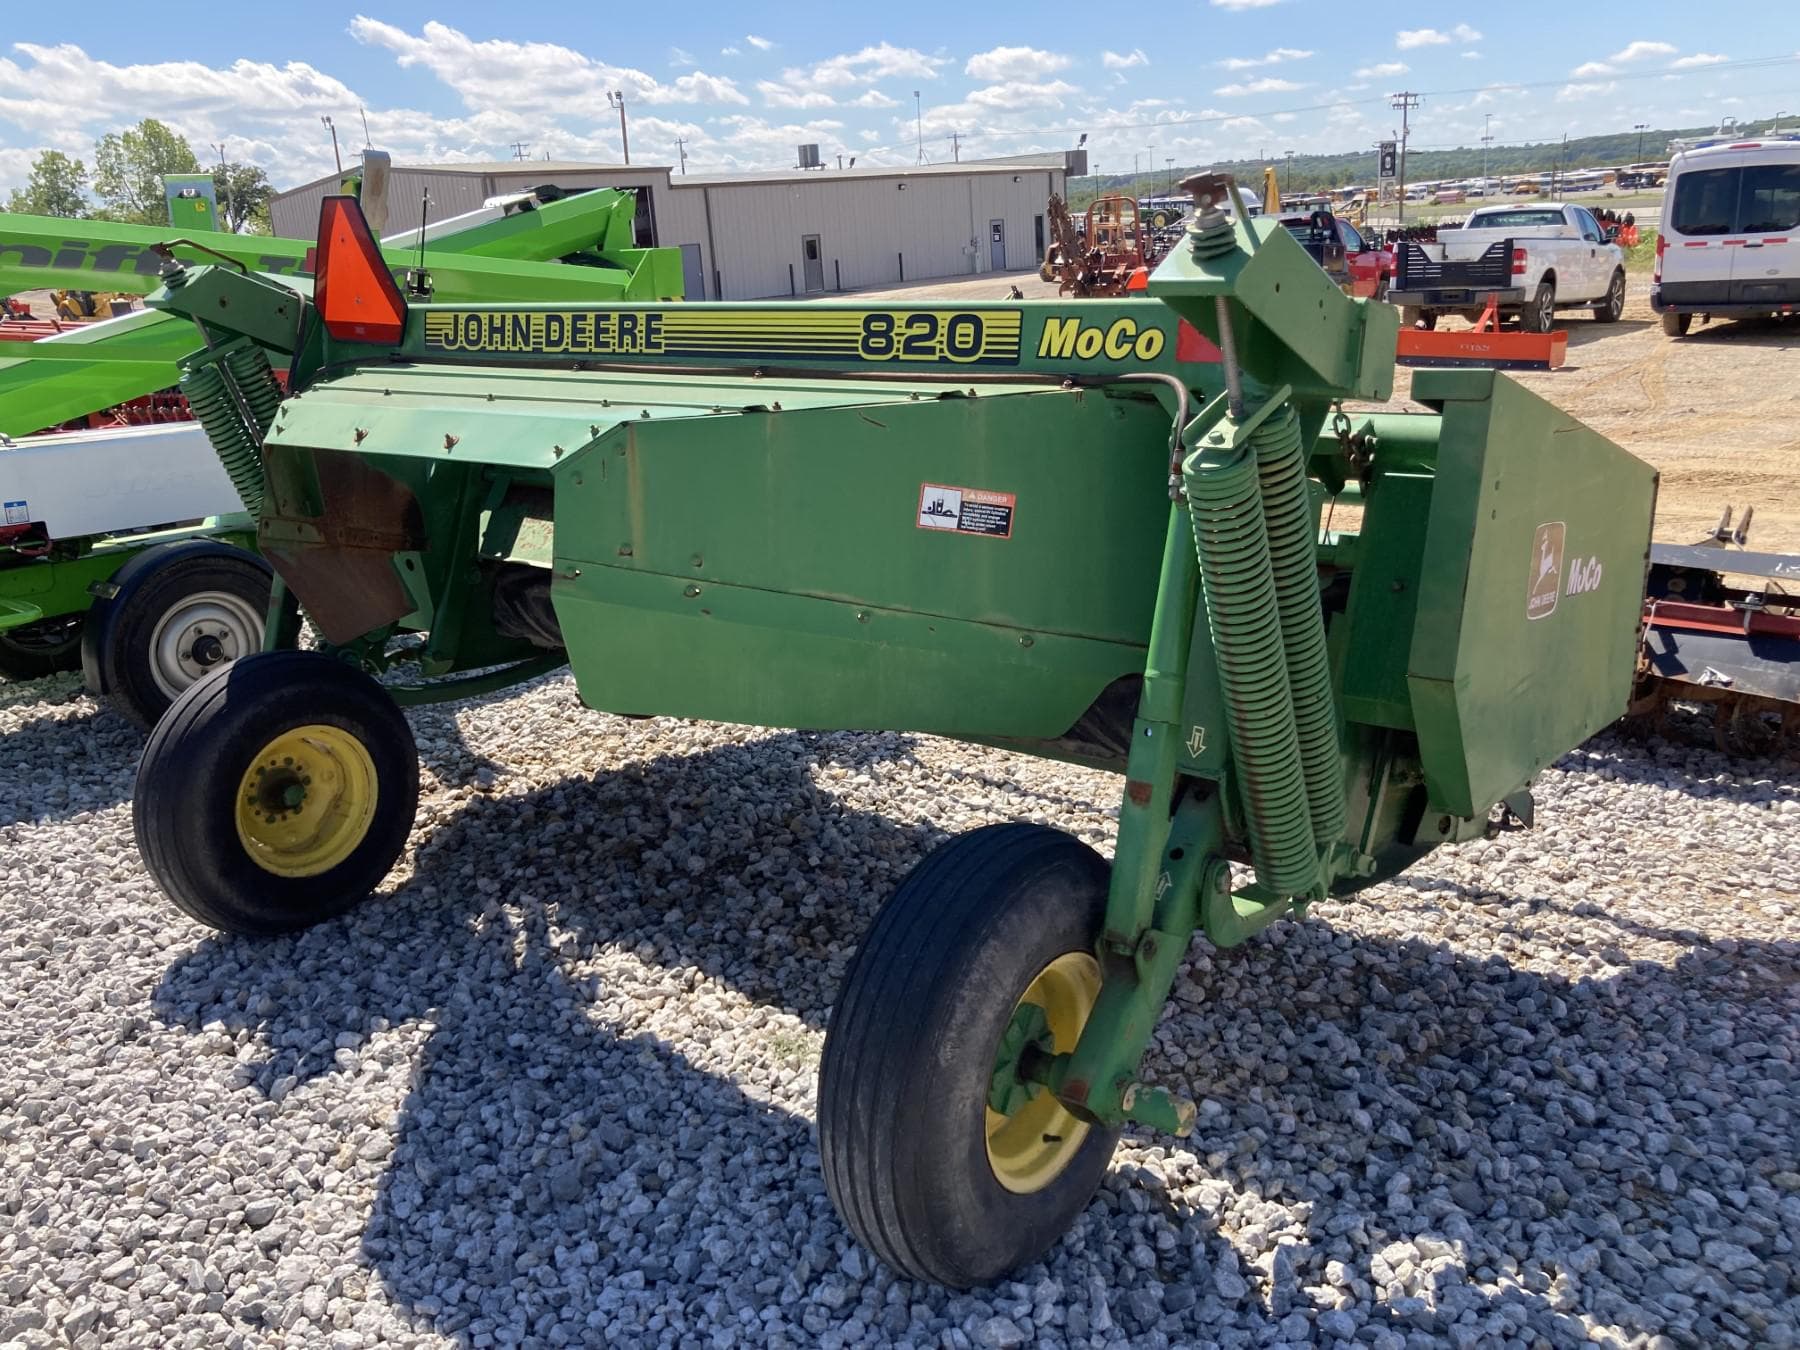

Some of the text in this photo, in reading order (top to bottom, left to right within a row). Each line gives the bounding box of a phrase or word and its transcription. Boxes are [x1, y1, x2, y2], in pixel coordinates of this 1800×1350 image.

[442, 313, 664, 353] JOHN DEERE
[859, 313, 985, 362] 820
[1037, 317, 1166, 361] MoCo
[977, 494, 1007, 503] DANGER
[1566, 556, 1602, 595] MoCo
